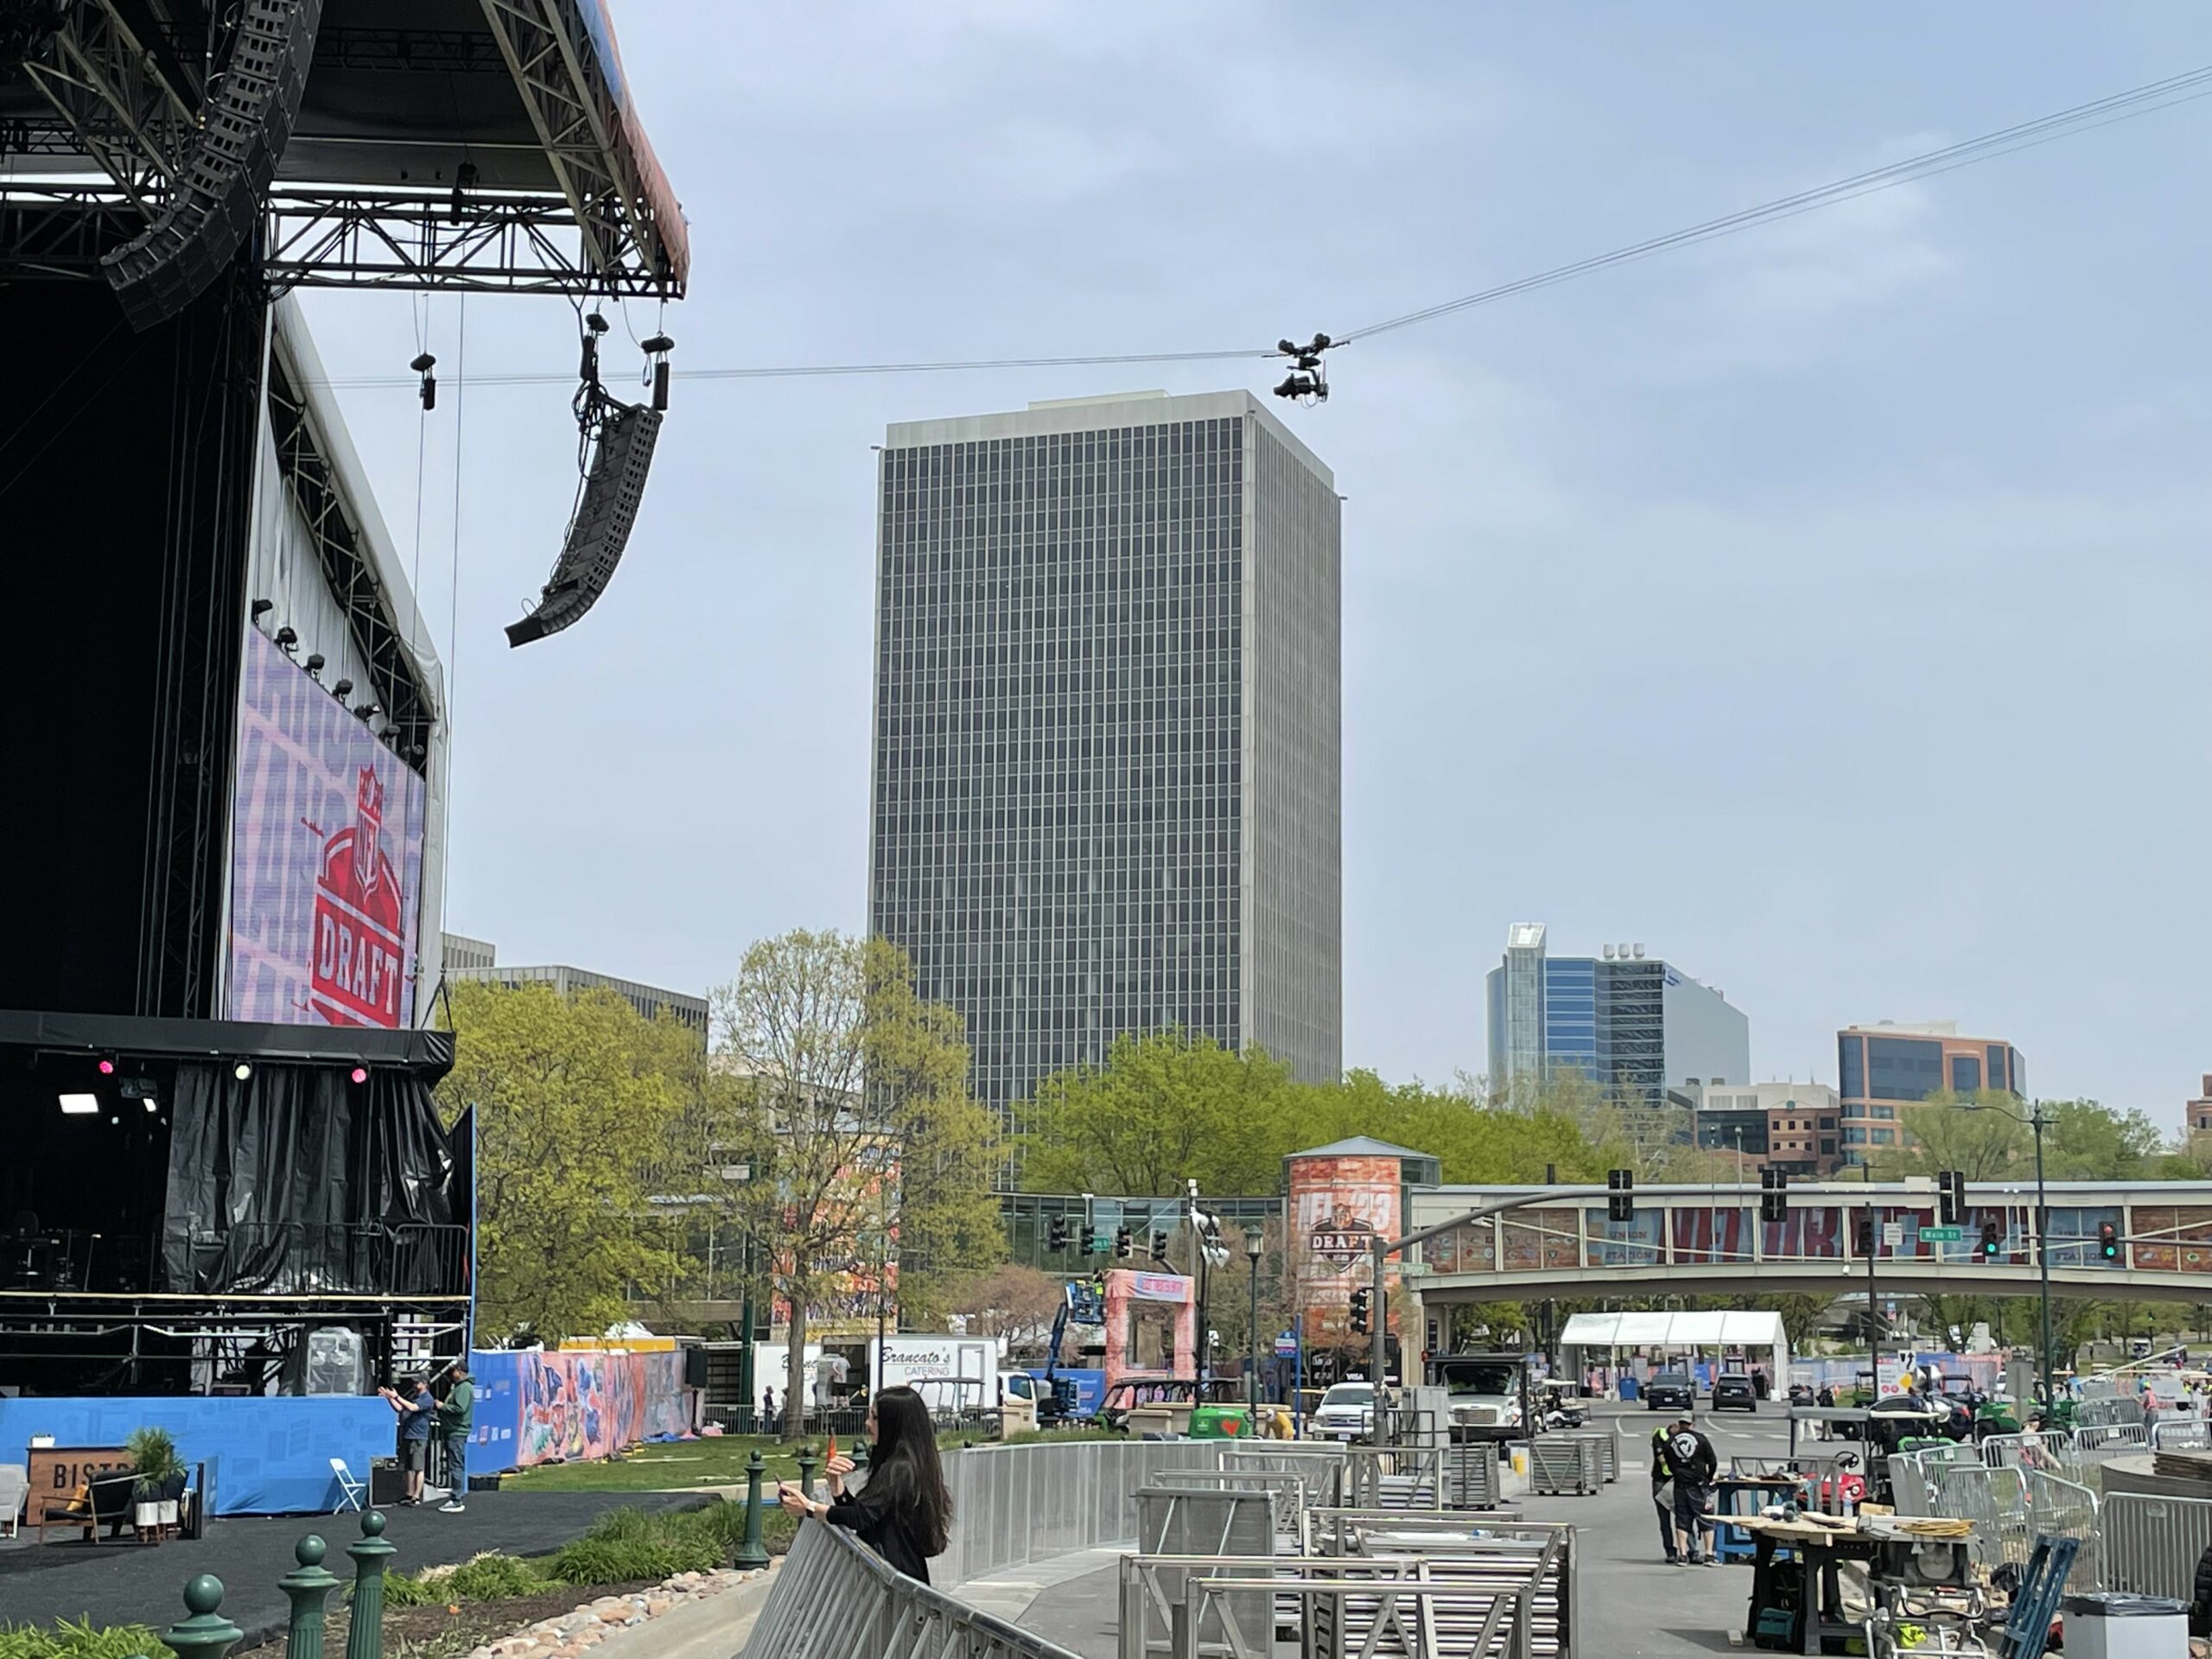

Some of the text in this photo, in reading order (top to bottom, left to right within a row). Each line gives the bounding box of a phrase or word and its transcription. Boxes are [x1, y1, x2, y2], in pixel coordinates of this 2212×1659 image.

[319, 912, 398, 1015] DRAFT
[1610, 1230, 1647, 1239] UNON
[1925, 1230, 1945, 1239] Main
[1312, 1235, 1372, 1249] DRAFT
[881, 1346, 950, 1364] Brancato's
[905, 1366, 950, 1376] CATERING
